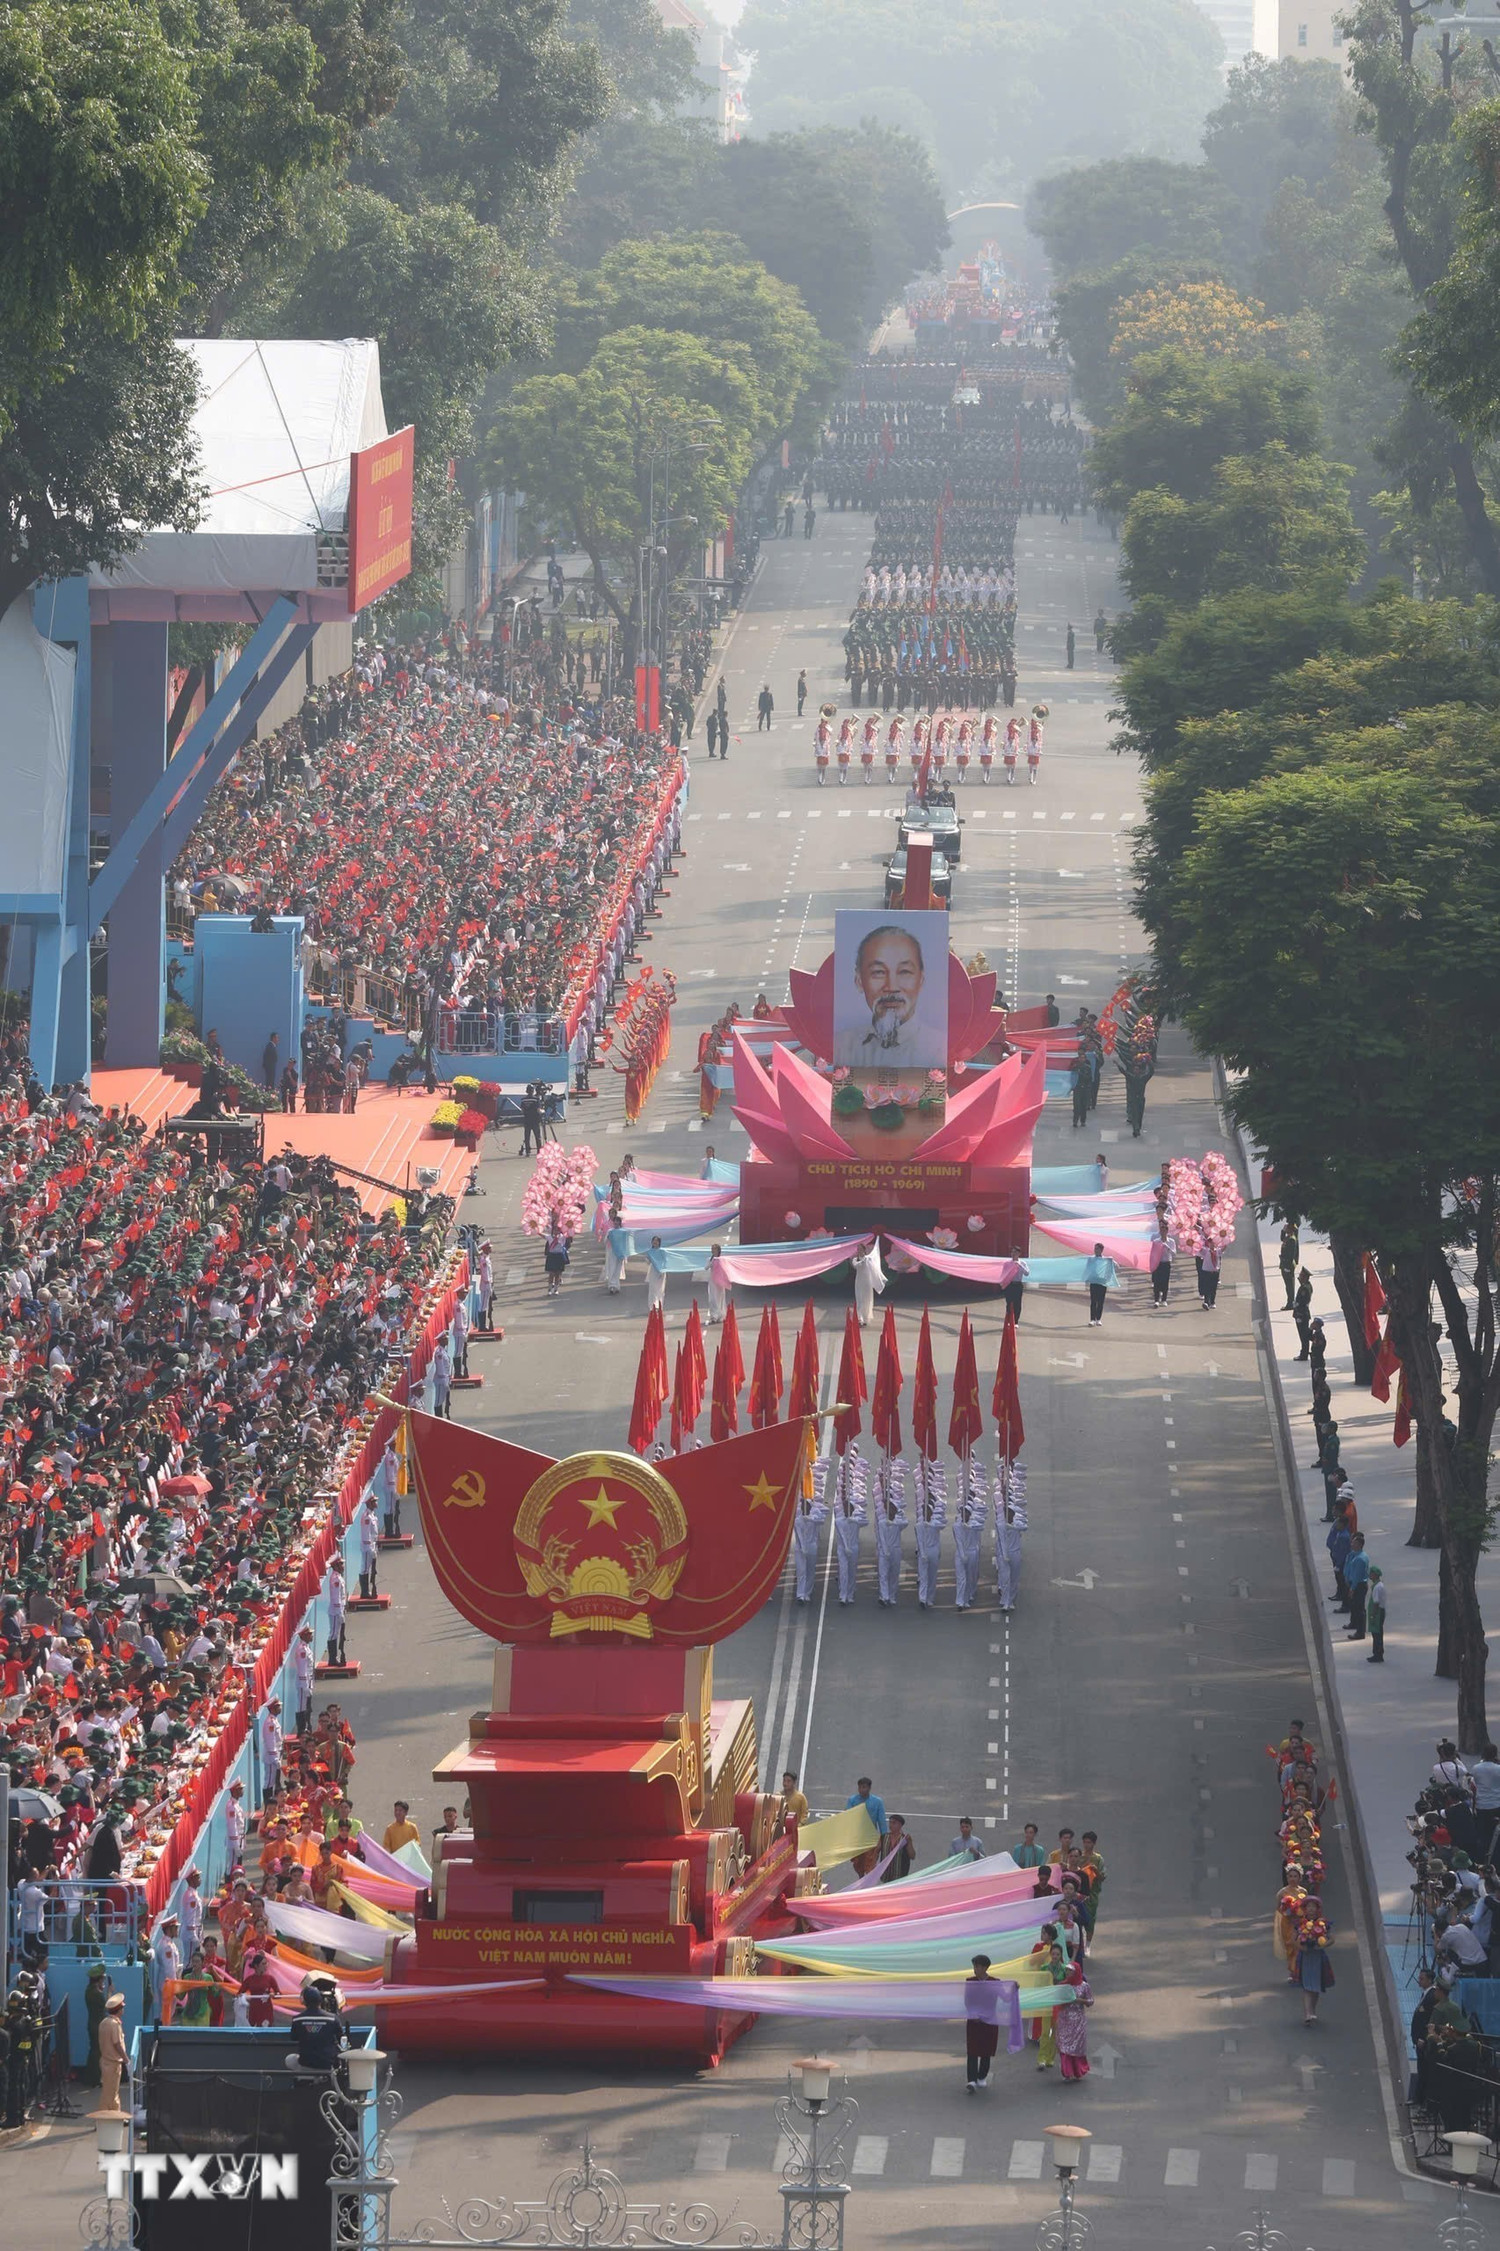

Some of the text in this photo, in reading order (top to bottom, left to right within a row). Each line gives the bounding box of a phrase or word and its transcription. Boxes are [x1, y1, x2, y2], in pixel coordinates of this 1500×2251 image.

[807, 1161, 962, 1177] CHỦ TỊCH HỒ CHÍ MINH
[844, 1179, 878, 1190] (1890
[892, 1179, 925, 1191] 1969)
[432, 1926, 675, 1944] NƯỚC CỘNG HÒA XÃ HỘI CHỦ NGHĨA
[478, 1949, 510, 1965] VIỆT
[513, 1951, 545, 1963] NAM
[548, 1950, 590, 1964] MUÔN
